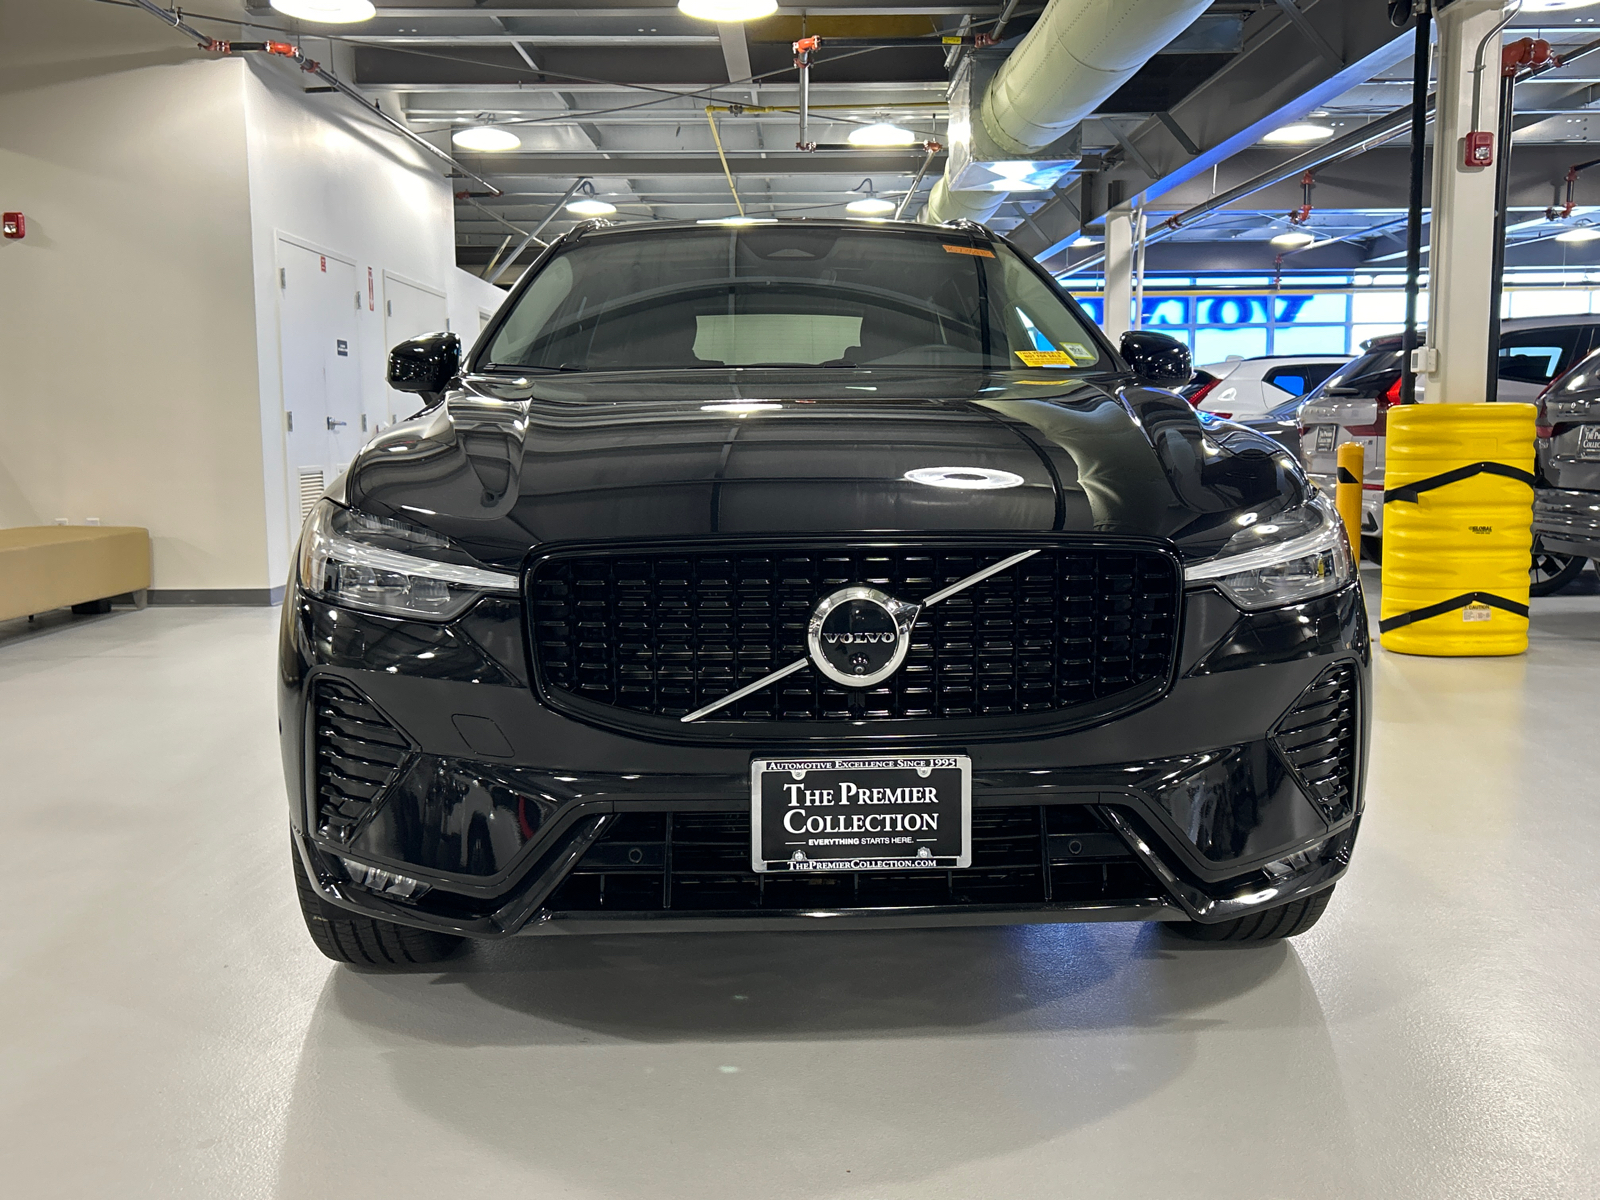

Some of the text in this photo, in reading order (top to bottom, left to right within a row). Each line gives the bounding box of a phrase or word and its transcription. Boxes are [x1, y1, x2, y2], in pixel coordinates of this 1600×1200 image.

[822, 632, 896, 644] VOLVO
[768, 758, 956, 770] AUTOMOTIVE EXCELLENCE SINCE 1995
[783, 782, 939, 807] THE PREMIER
[783, 808, 940, 834] COLLECTION
[808, 836, 914, 846] EVERYTHING STARTS HERE.
